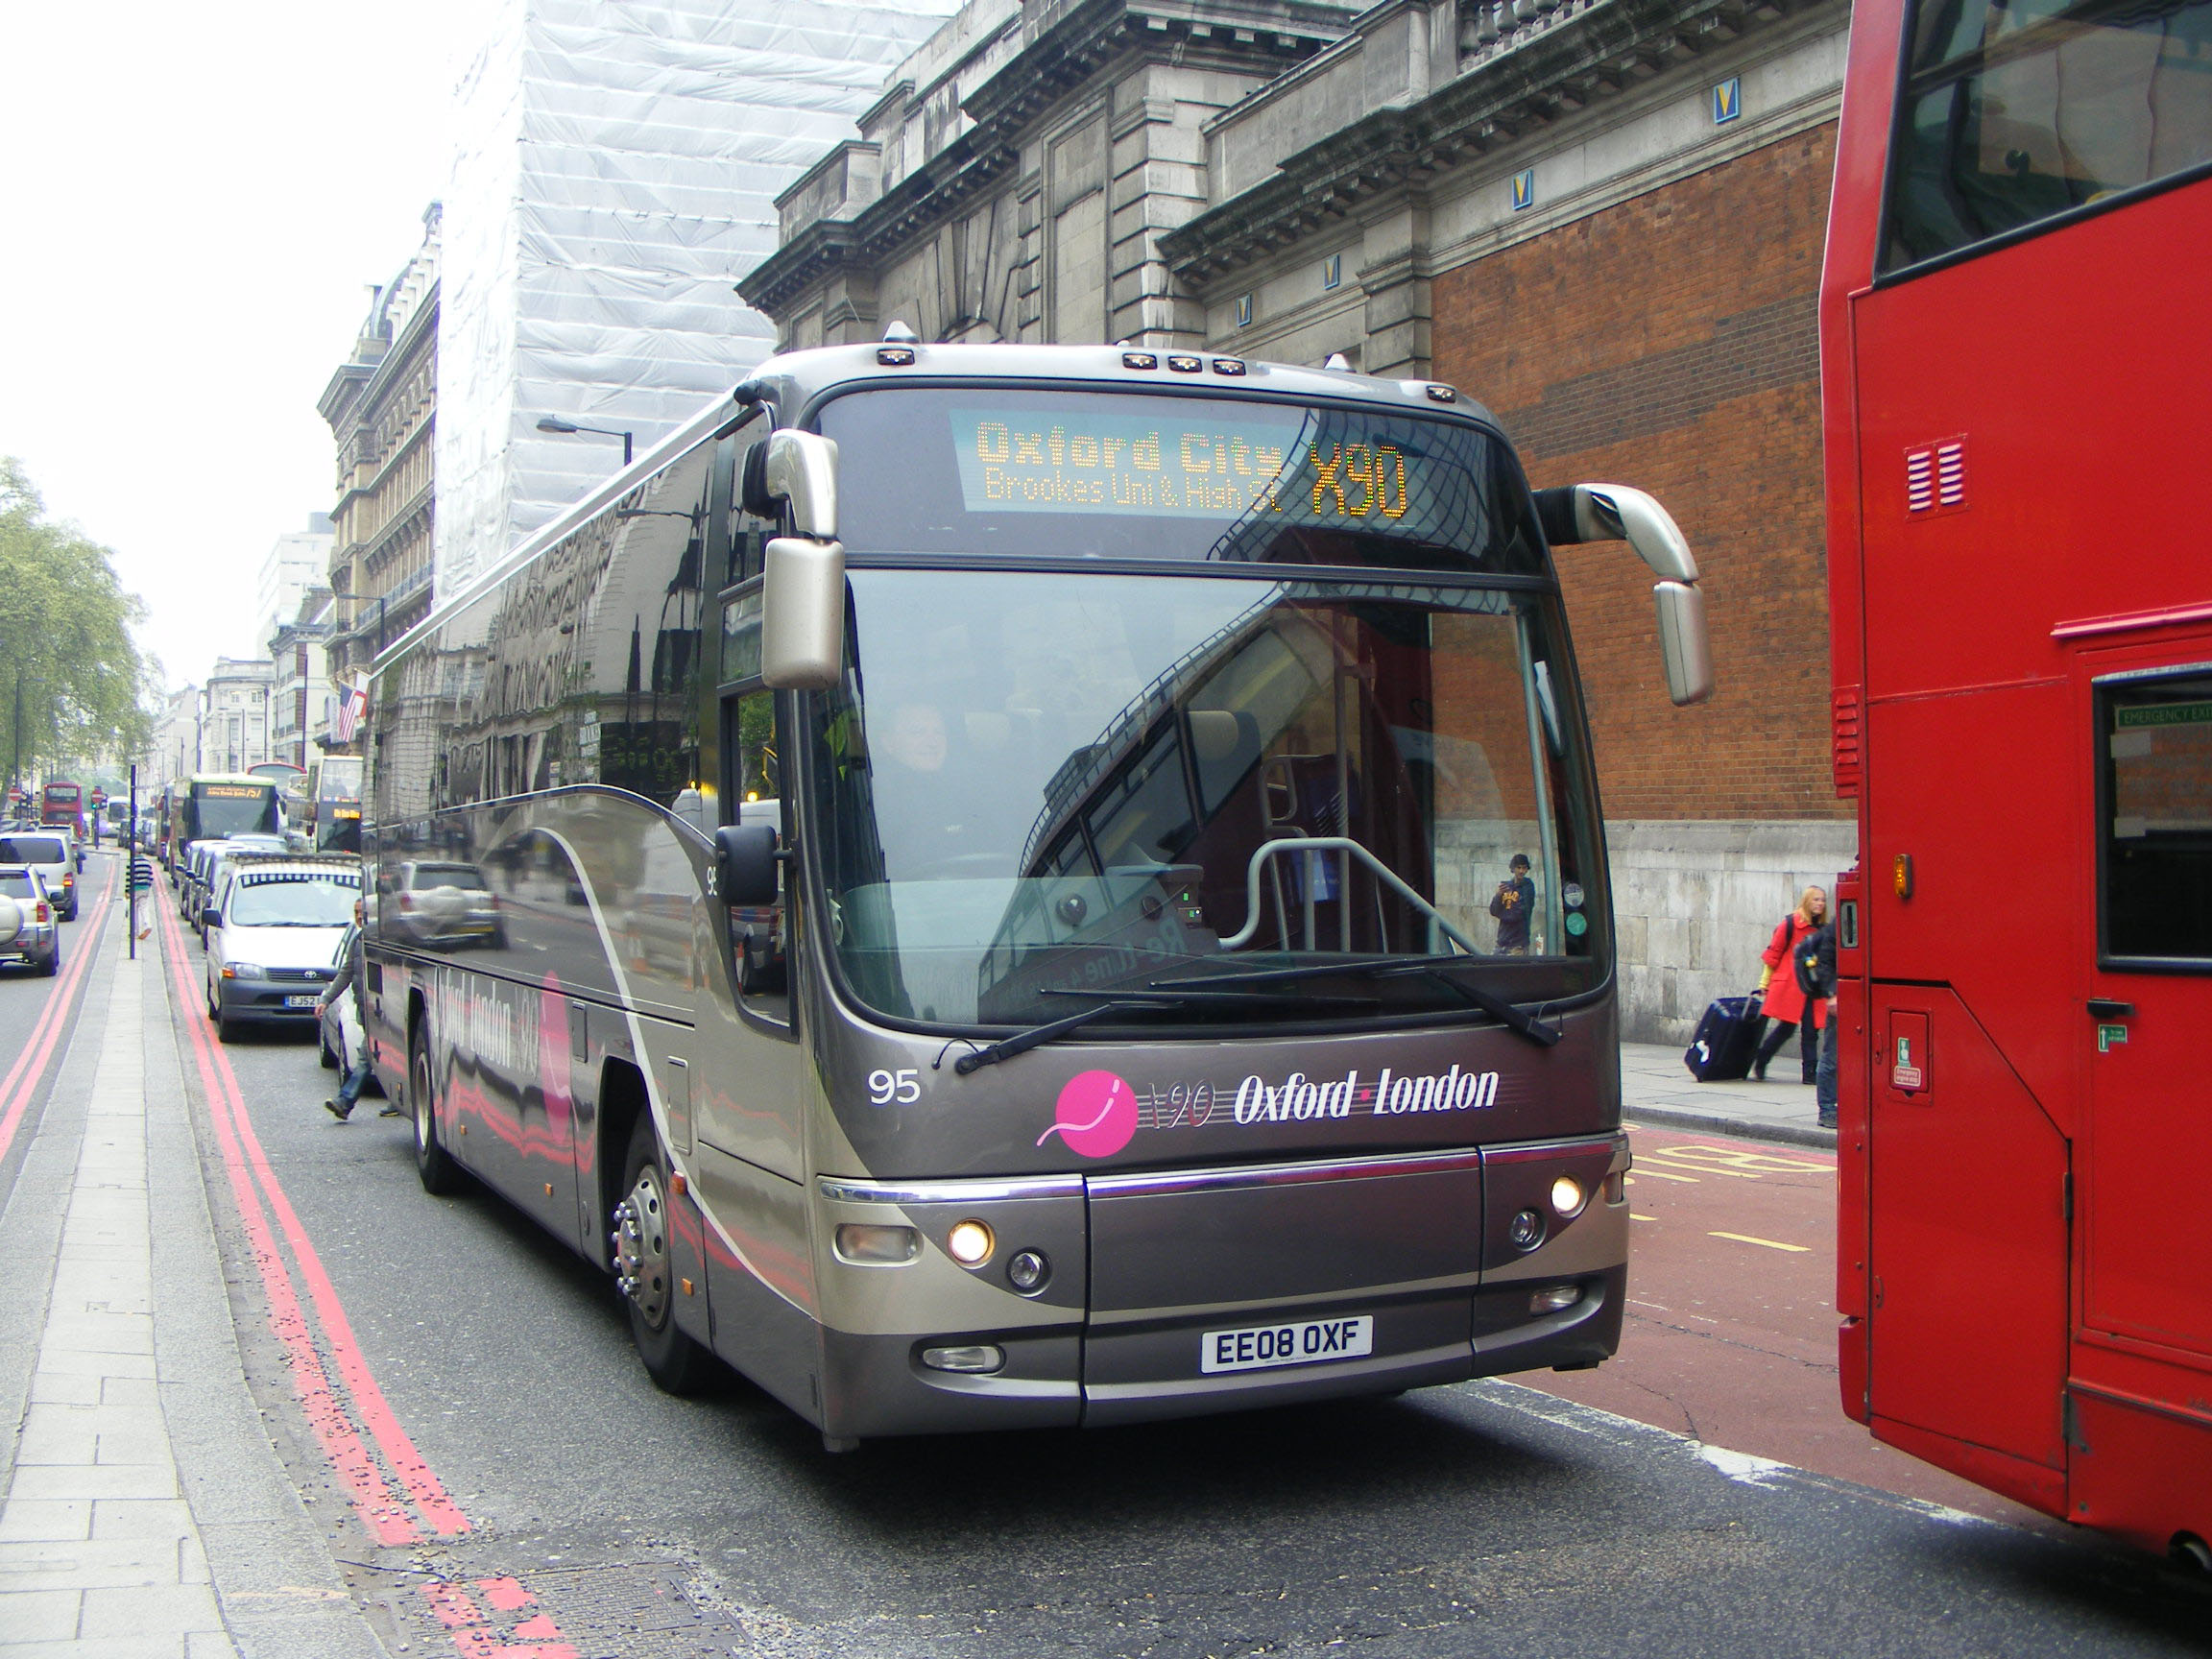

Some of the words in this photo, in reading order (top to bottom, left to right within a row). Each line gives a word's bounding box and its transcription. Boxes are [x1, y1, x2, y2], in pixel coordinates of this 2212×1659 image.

[976, 421, 1161, 470] Oxford
[1180, 433, 1283, 477] City
[984, 467, 1103, 502] Brookes
[1111, 473, 1155, 507] Uni
[1161, 478, 1179, 508] &
[1186, 476, 1242, 512] High
[1309, 440, 1408, 518] X90
[2124, 707, 2188, 724] EMERGENCY
[291, 997, 315, 1005] EJ52
[470, 975, 510, 1068] London
[867, 1068, 920, 1105] 95
[1234, 1070, 1358, 1126] Oxford
[1374, 1064, 1501, 1116] London
[1216, 1329, 1294, 1364] EE08
[1304, 1320, 1359, 1355] OXF
